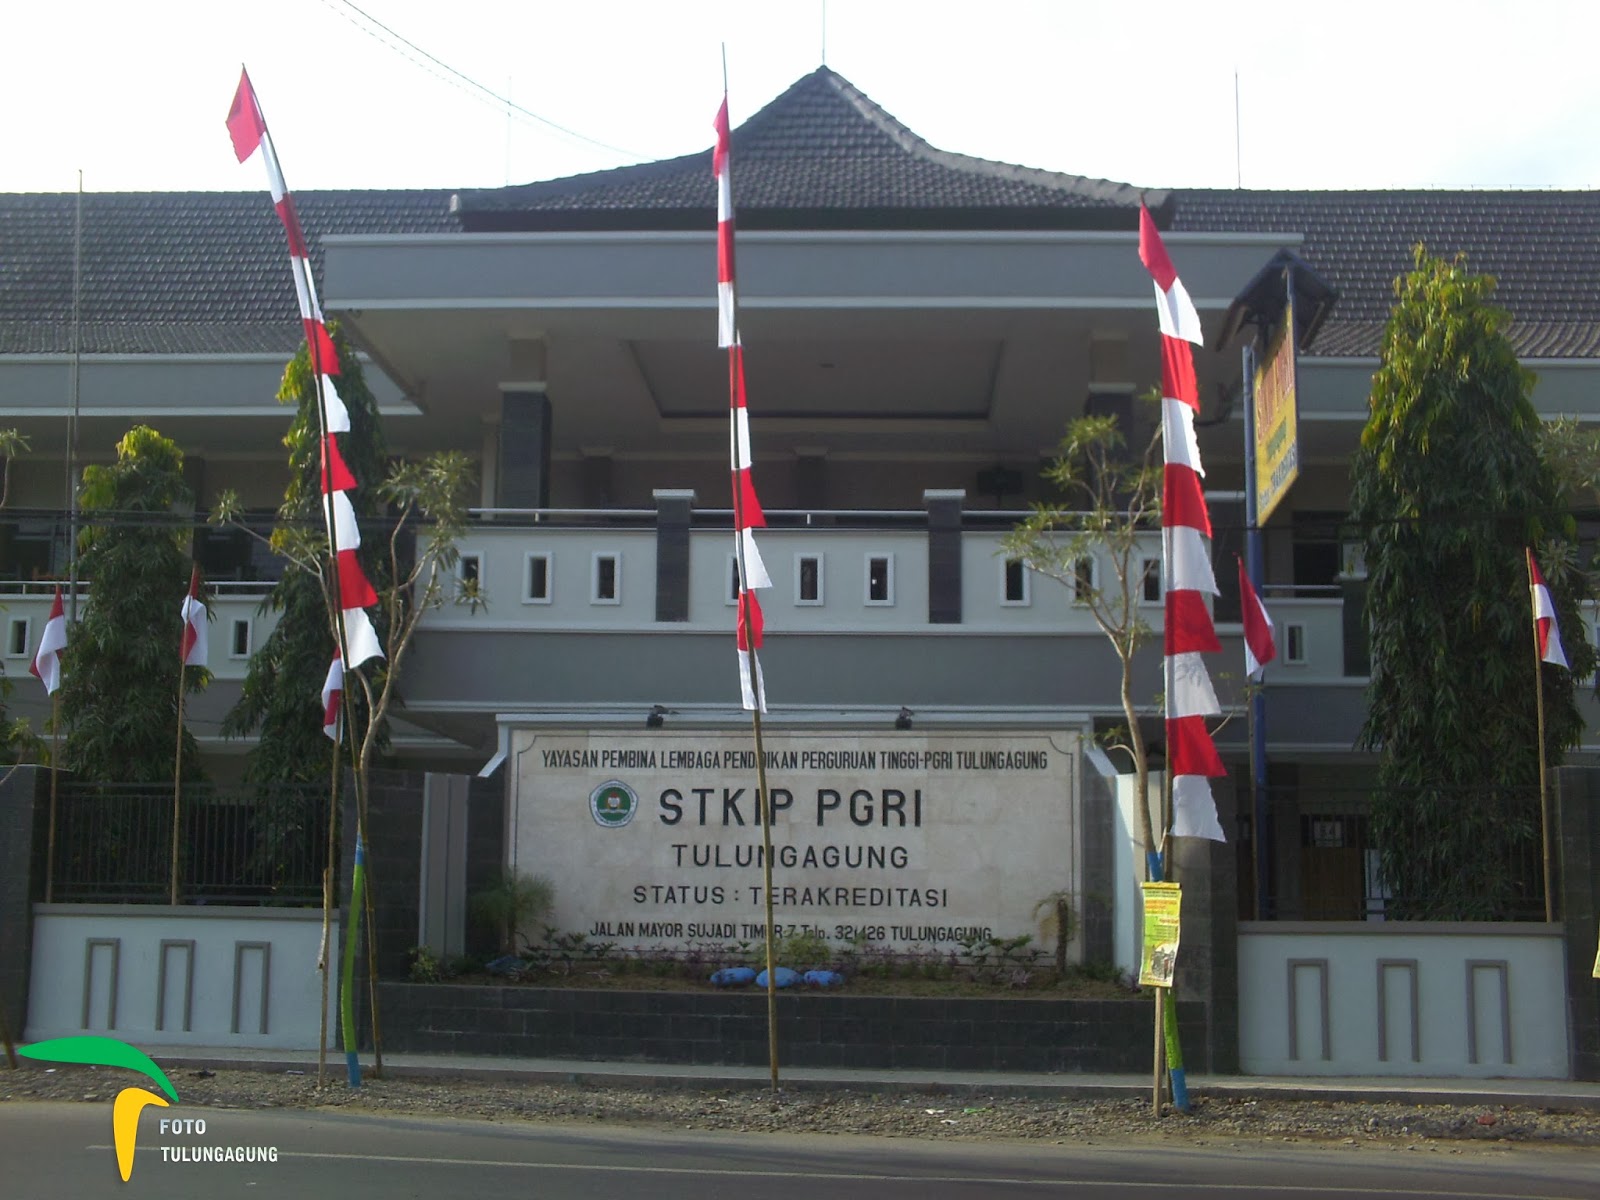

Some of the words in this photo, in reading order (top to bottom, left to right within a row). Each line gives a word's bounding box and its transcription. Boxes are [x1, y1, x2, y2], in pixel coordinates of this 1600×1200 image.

[542, 750, 599, 768] YAYASAN
[601, 750, 656, 769] PEMBINA
[660, 750, 721, 769] LEMBAGA
[801, 751, 876, 770] PERGURUAN
[880, 751, 953, 770] TINGGI-PGRI
[956, 751, 1048, 770] TULUNGAGUNG
[659, 787, 794, 826] STKIP
[816, 788, 922, 827] PGRI
[671, 844, 909, 869] TULUNGAGUNG
[633, 885, 725, 904] STATUS
[749, 885, 947, 908] TERAKREDITASI
[590, 922, 635, 937] JALAN
[638, 923, 683, 938] MAYOR
[687, 923, 736, 938] SUJADI
[741, 924, 783, 939] TIMR
[890, 925, 992, 942] TULUNGAGUNG
